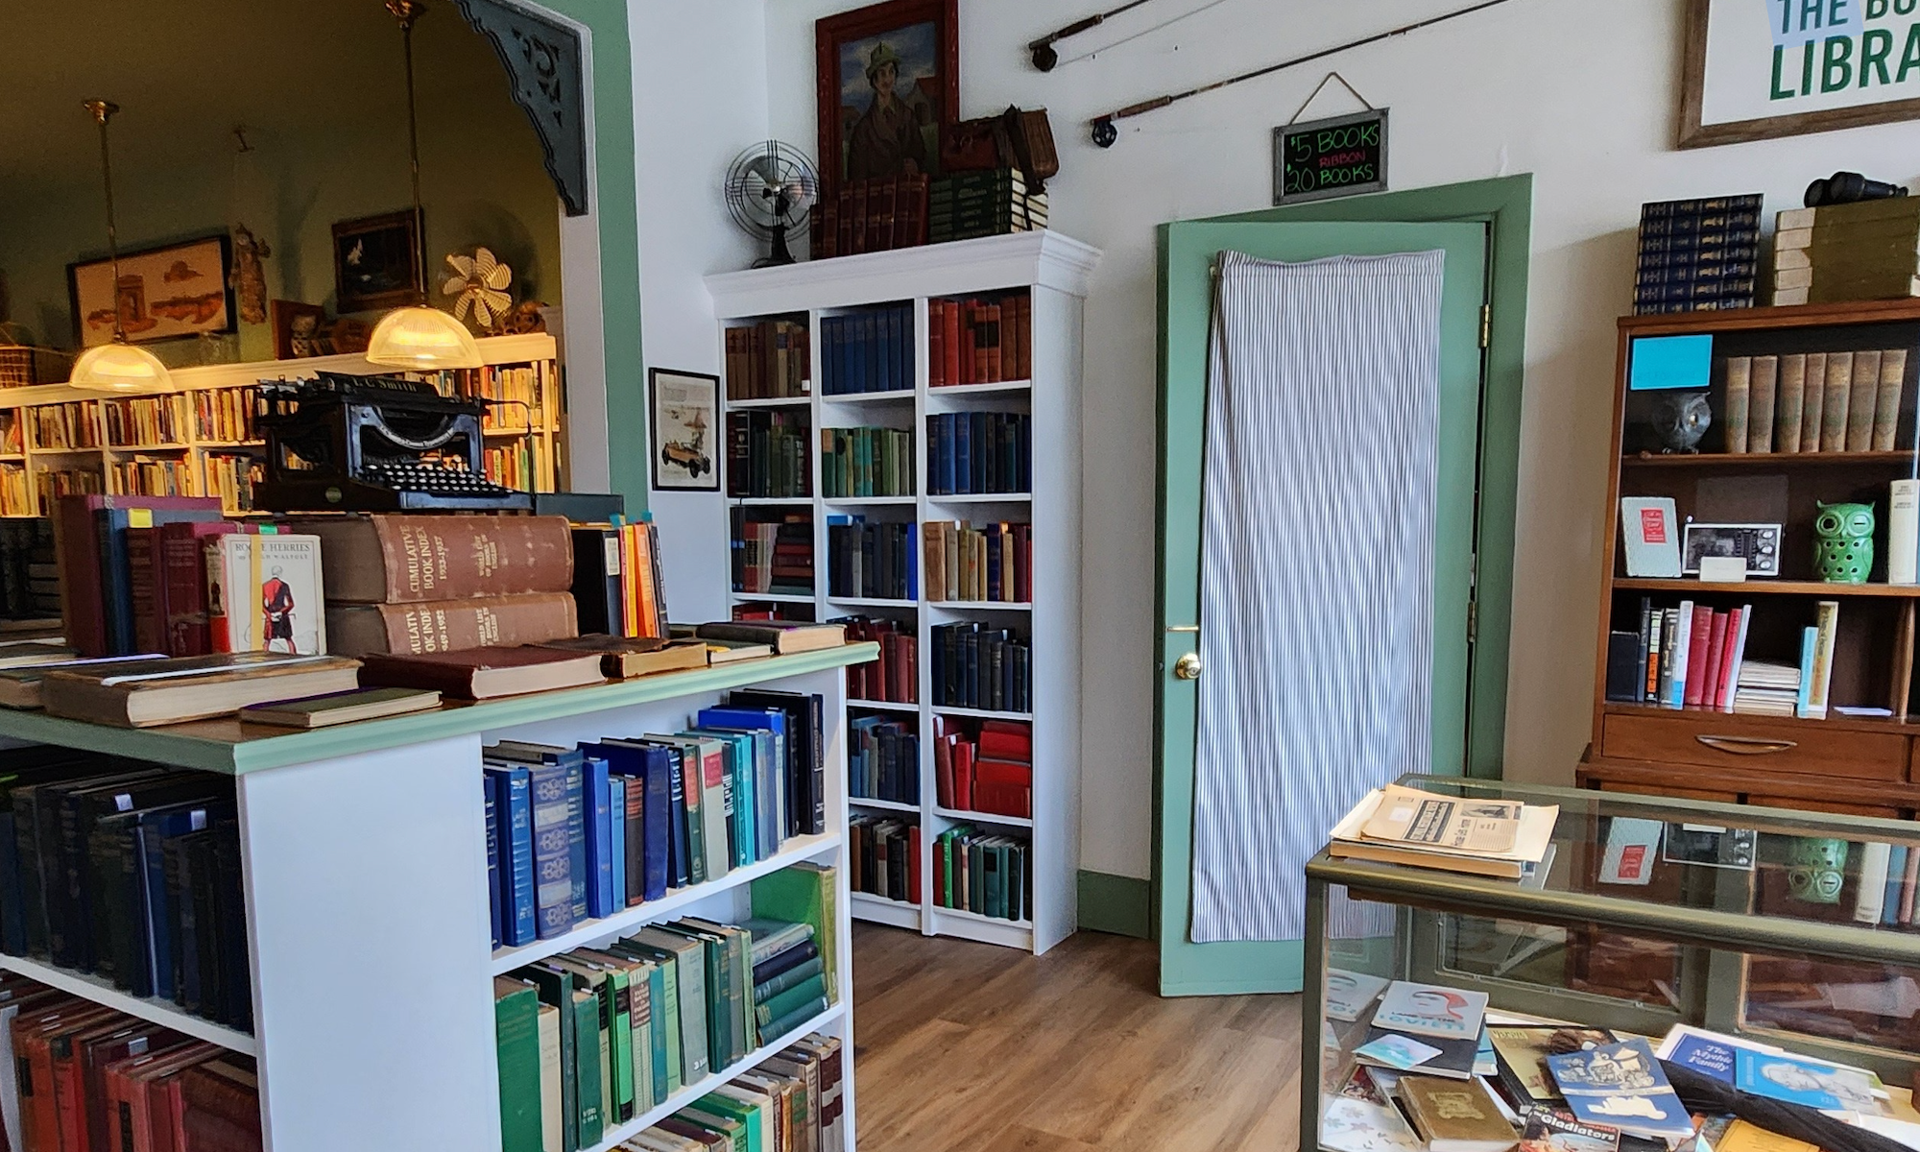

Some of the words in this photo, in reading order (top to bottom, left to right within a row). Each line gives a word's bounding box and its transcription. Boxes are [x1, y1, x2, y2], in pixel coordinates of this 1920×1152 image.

[1777, 0, 1848, 34] THE
[1290, 134, 1312, 162] $5
[1317, 124, 1379, 153] BOOKS
[1318, 150, 1366, 168] RIBBON
[1285, 163, 1315, 192] $20
[1320, 163, 1374, 186] BOOKS
[269, 543, 310, 552] HERRIES
[415, 525, 433, 557] INDEX
[399, 525, 420, 593] CUMULATIVE
[421, 558, 435, 590] BOOK
[423, 635, 437, 652] OK
[436, 609, 449, 652] 949-1952
[1688, 1056, 1730, 1072] Family
[1706, 1044, 1730, 1055] The
[1540, 1113, 1616, 1141] Gladiators
